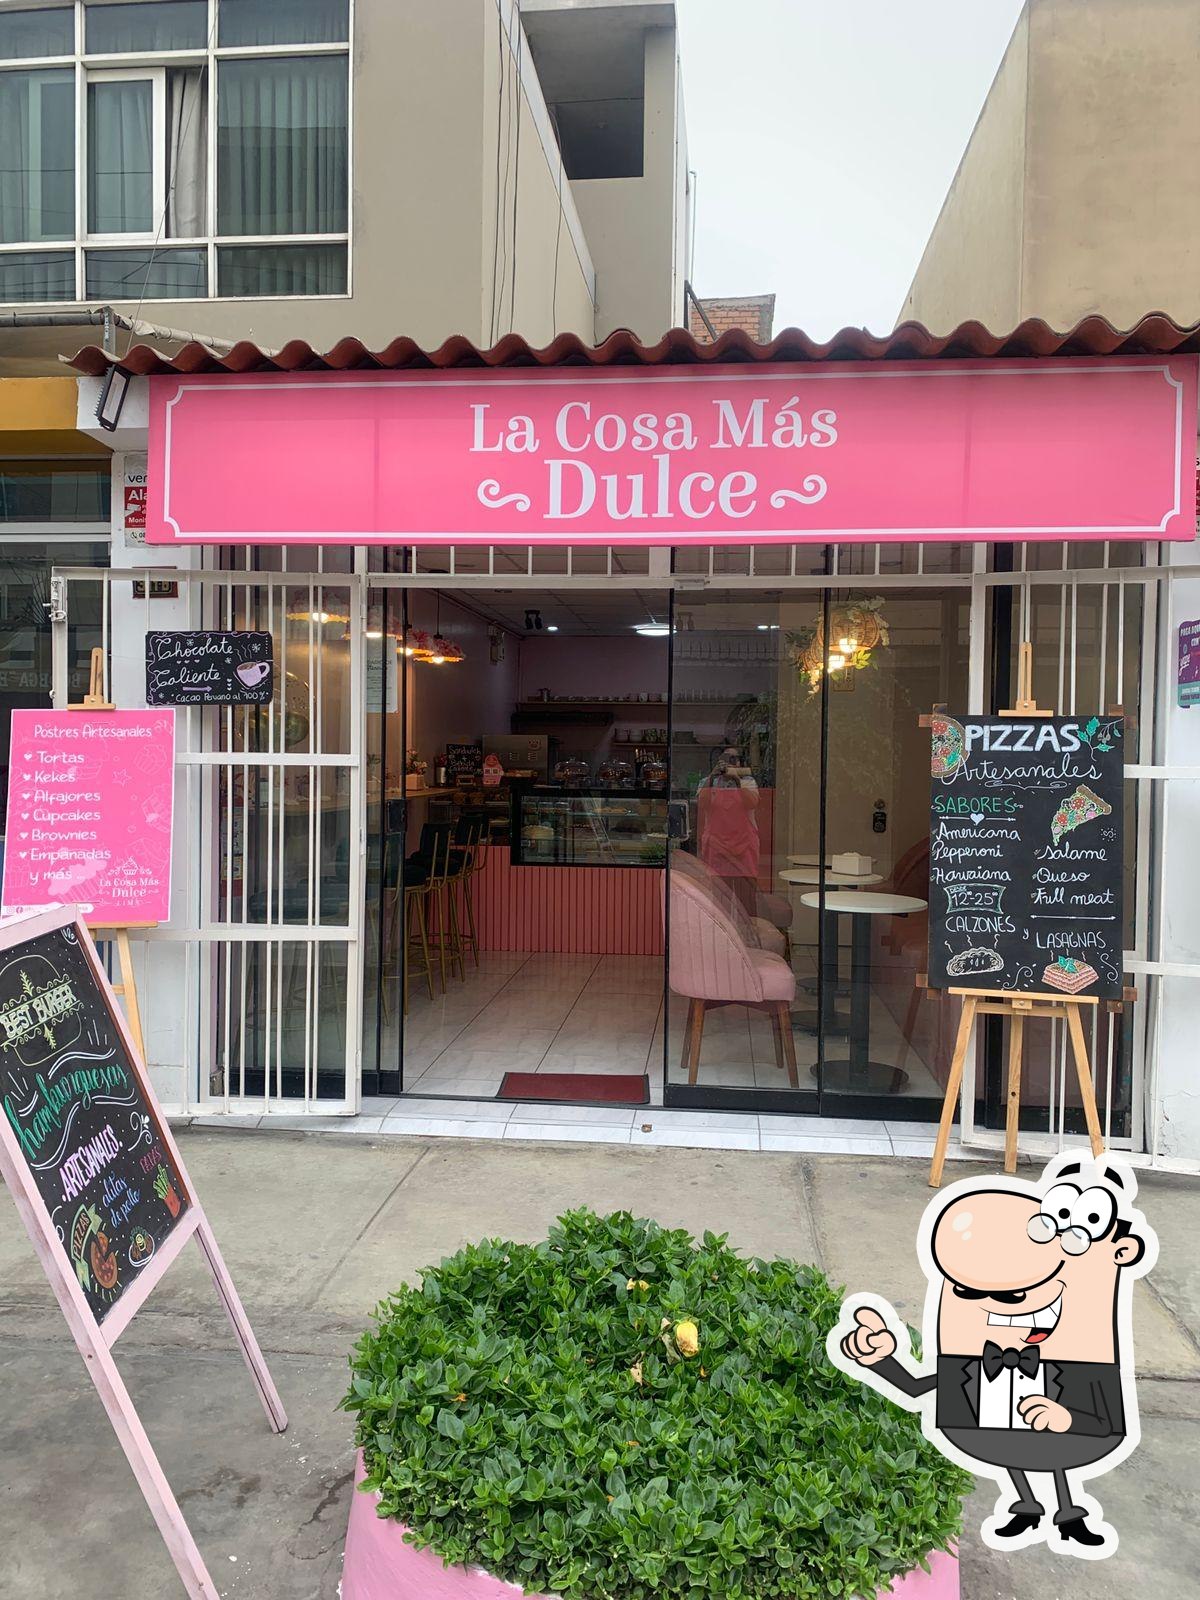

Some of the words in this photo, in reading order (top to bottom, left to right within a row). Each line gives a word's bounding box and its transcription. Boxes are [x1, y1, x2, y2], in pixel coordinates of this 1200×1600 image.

[469, 403, 539, 452] La
[556, 401, 697, 452] Cosa
[710, 396, 838, 448] Más
[543, 453, 757, 520] Dulce
[156, 637, 233, 661] Chocolate
[153, 663, 220, 691] Caliente
[204, 692, 231, 700] Peruano
[232, 692, 241, 701] al
[34, 724, 78, 738] Postres
[81, 724, 152, 739] Artesanales
[965, 723, 1081, 752] PIZZAS
[37, 751, 85, 763] Tortas
[34, 771, 76, 783] Kekes
[941, 752, 1102, 785] Artesanales
[34, 790, 101, 804] Alfajores
[934, 795, 1016, 814] SABORES
[33, 810, 101, 825] Cupcakes
[31, 829, 97, 841] Brownies
[935, 822, 1022, 841] Americana
[31, 848, 111, 864] Empanadas
[932, 840, 1004, 864] Pepperoni
[30, 871, 39, 886] y
[43, 867, 73, 880] más
[114, 878, 137, 887] Cosa
[932, 866, 1011, 884] Hawaiana
[1036, 867, 1090, 883] Queso
[112, 886, 147, 898] Dulce
[1033, 887, 1065, 905] Full
[1070, 888, 1114, 905] meat
[945, 916, 1016, 933] CALZONES
[1035, 932, 1106, 949] LASAGNAS
[0, 1004, 33, 1038] BEST
[32, 984, 77, 1023] BURGER
[4, 1064, 128, 1160] hamburguesas
[60, 1124, 119, 1201] ARTESANALES
[73, 1212, 90, 1259] PIZZAS
